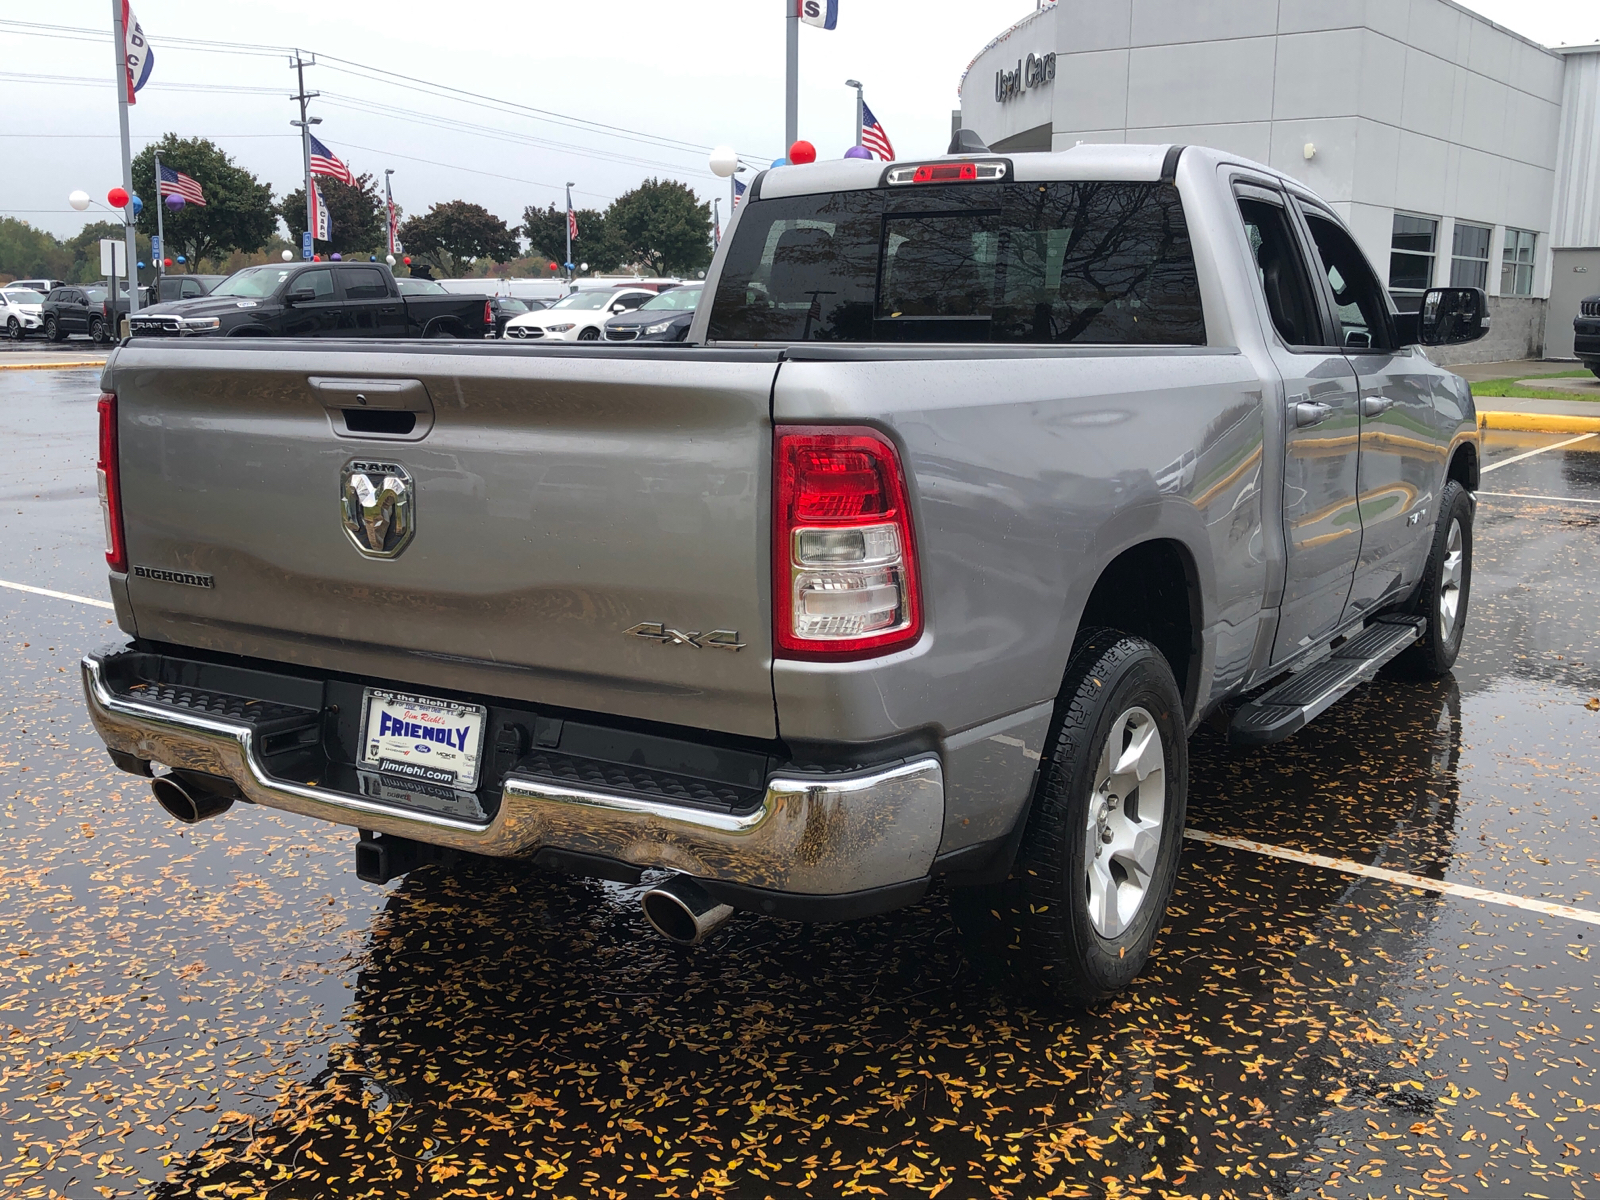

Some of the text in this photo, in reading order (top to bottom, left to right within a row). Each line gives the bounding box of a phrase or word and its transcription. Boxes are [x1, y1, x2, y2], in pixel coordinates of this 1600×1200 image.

[995, 52, 1056, 103] Used Cars
[353, 462, 396, 473] RAM
[133, 566, 210, 588] BIGHORN
[373, 690, 476, 713] Get the Riehl Deal
[403, 710, 446, 725] Jim Riehl's
[379, 710, 471, 753] FRIENDLY
[380, 760, 452, 782] jimriehl.com
